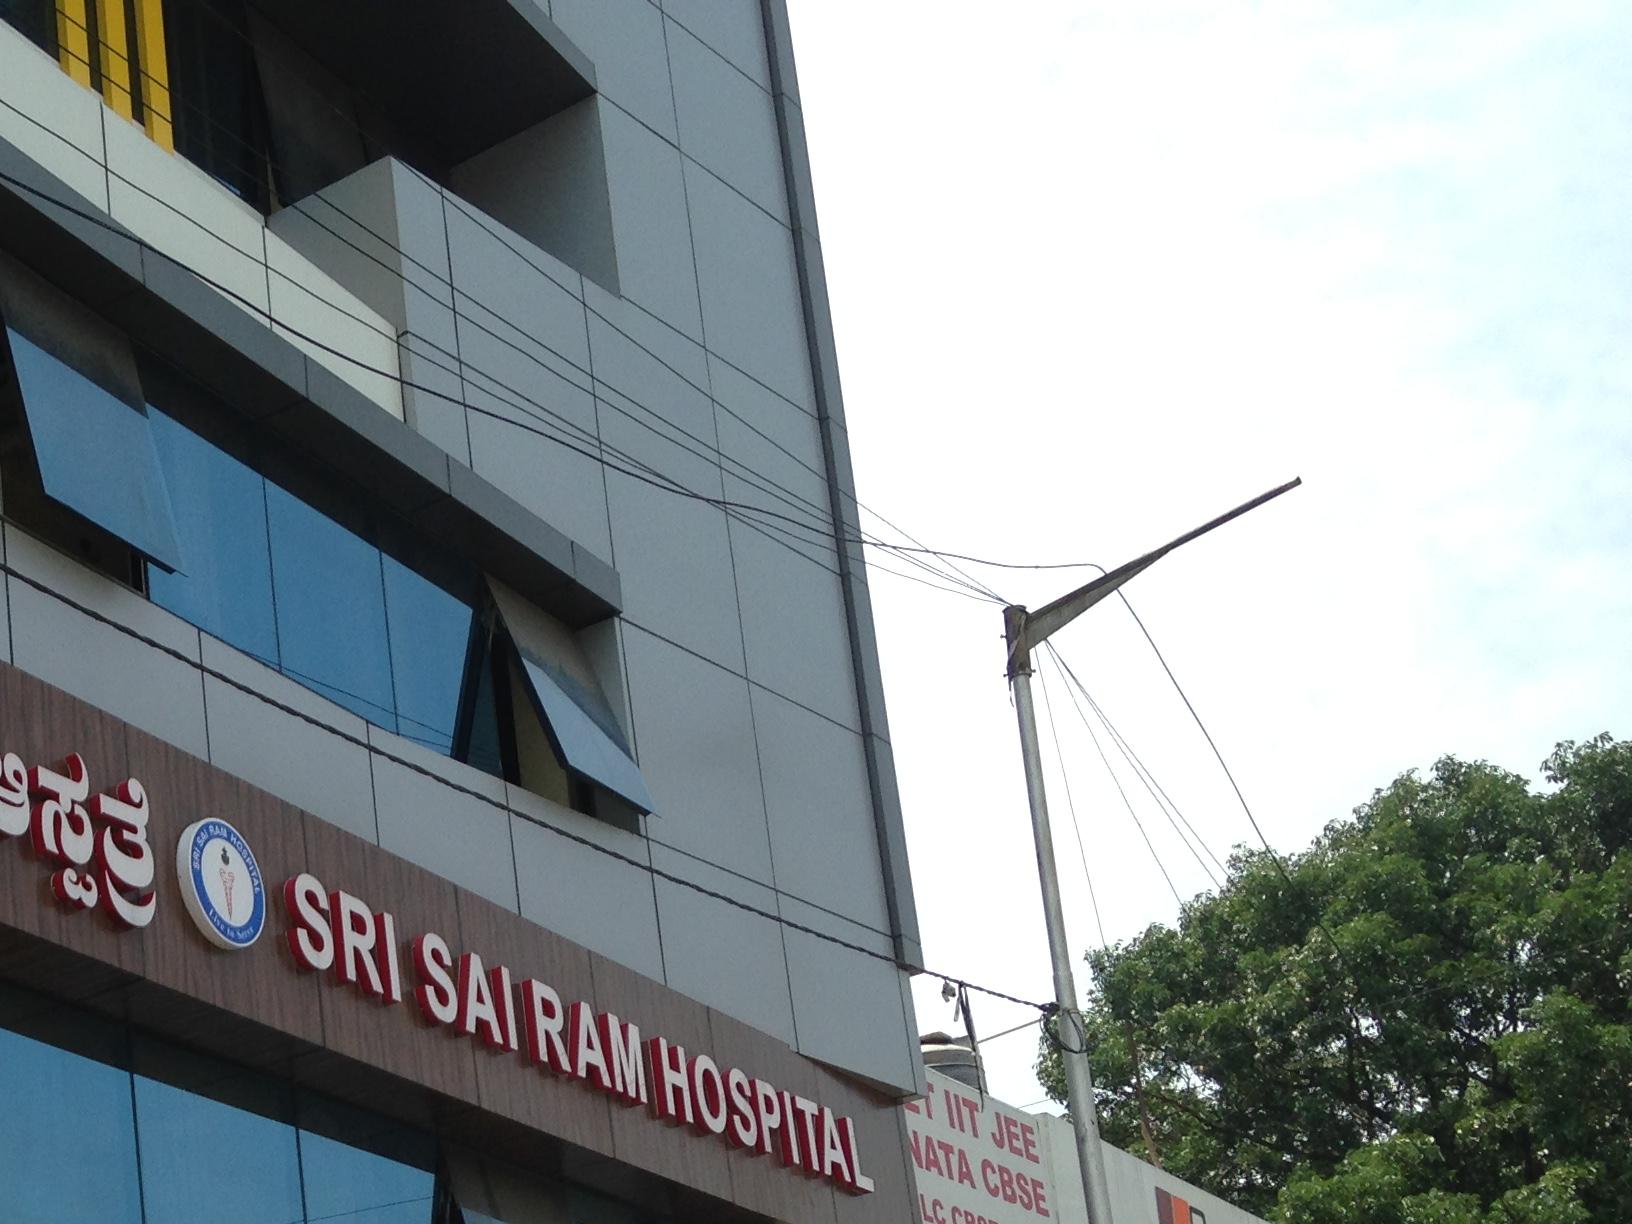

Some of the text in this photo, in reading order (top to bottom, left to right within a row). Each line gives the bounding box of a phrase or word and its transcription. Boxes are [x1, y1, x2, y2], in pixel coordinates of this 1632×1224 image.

[208, 824, 228, 838] RAM
[230, 833, 261, 894] HOSPITAL
[284, 872, 875, 1195] SRI SAI RAM HOSPITAL
[944, 1089, 980, 1138] IIT
[991, 1112, 1040, 1164] JEE
[981, 1158, 1050, 1217] CBSE
